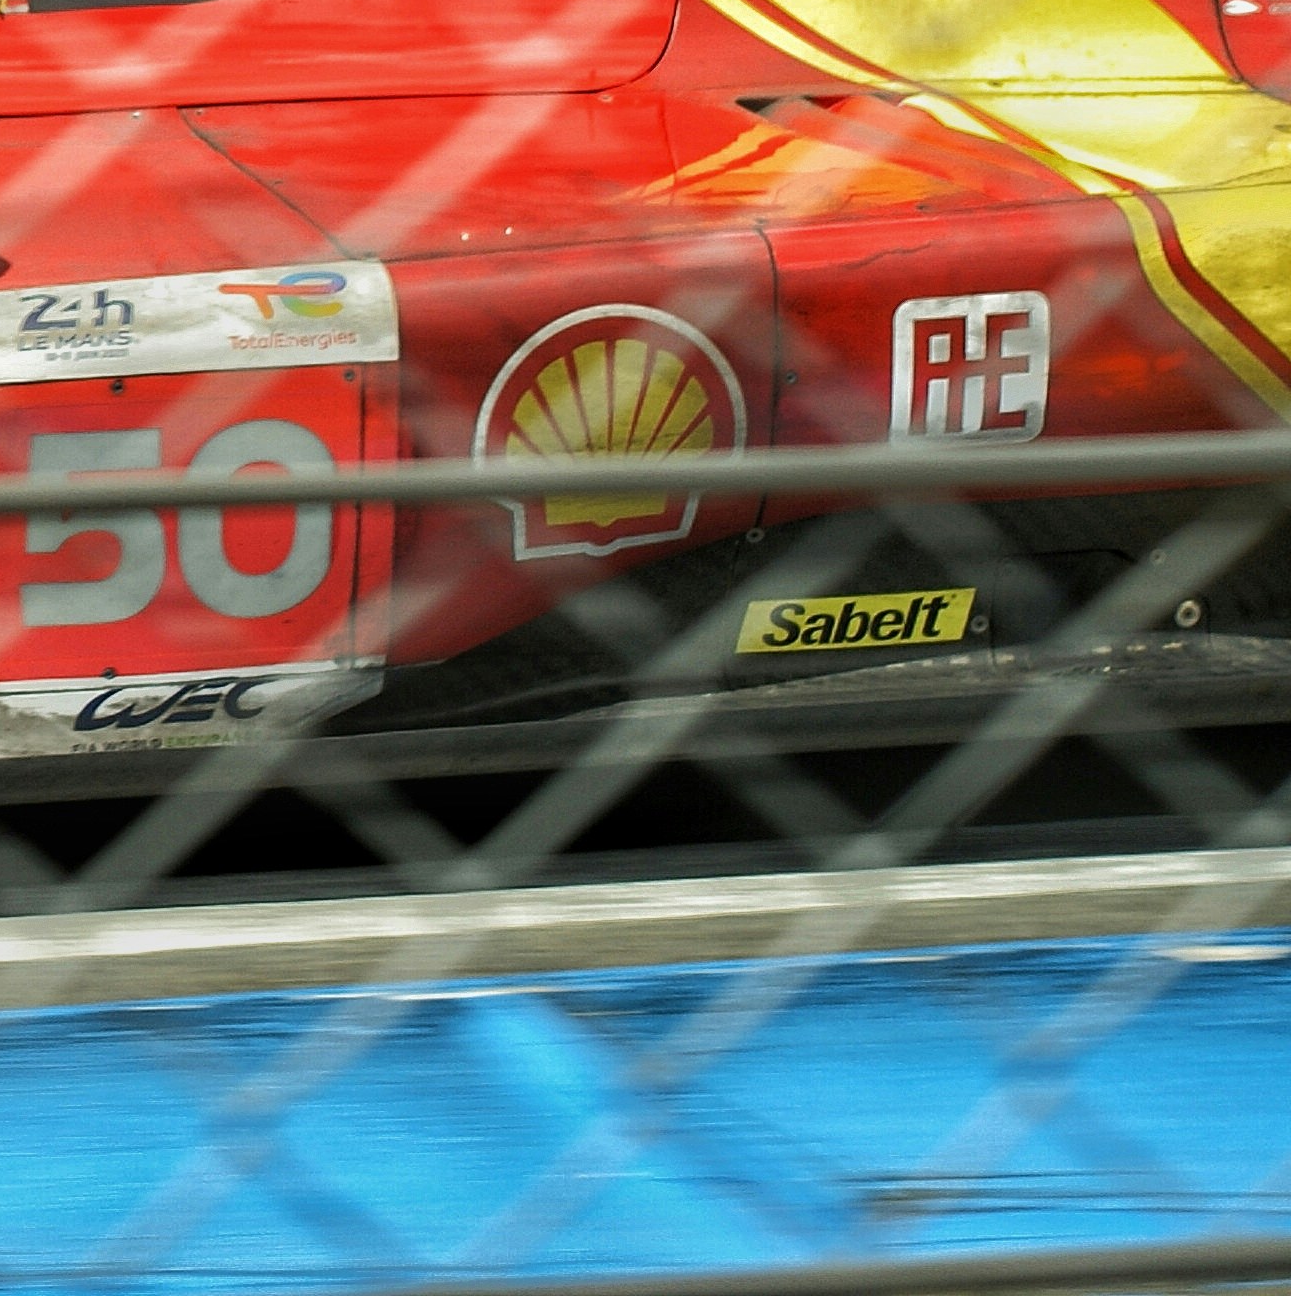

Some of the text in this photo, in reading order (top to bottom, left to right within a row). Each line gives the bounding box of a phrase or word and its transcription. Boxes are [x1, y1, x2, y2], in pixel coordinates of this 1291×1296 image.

[20, 288, 135, 331] 24h
[57, 330, 133, 350] MANS
[228, 330, 357, 350] TotalEnergies
[20, 418, 337, 627] 50
[761, 595, 949, 647] Sabelt
[73, 676, 281, 732] WEC
